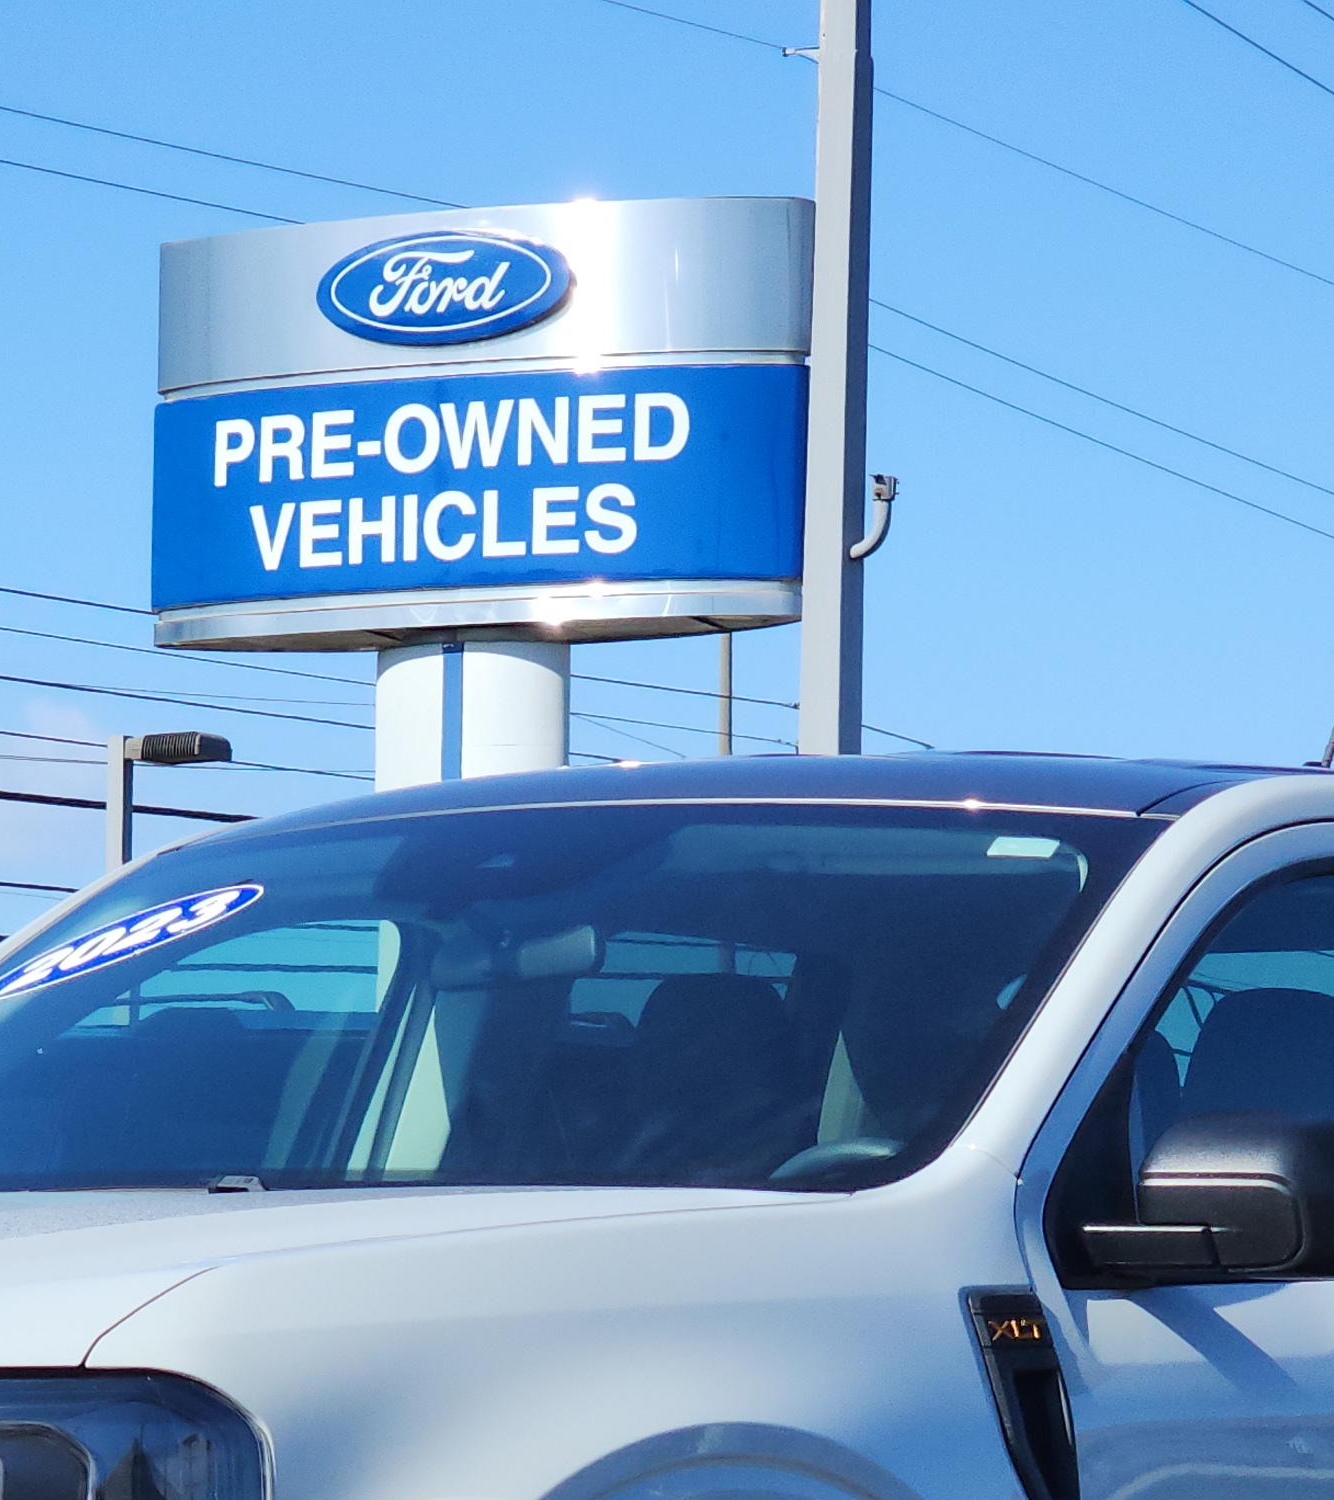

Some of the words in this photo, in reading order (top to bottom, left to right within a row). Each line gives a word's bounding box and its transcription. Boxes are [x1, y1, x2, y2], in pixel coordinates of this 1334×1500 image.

[369, 249, 510, 317] Ford
[213, 391, 690, 487] PRE-OWNED
[249, 482, 638, 571] VEHICLES
